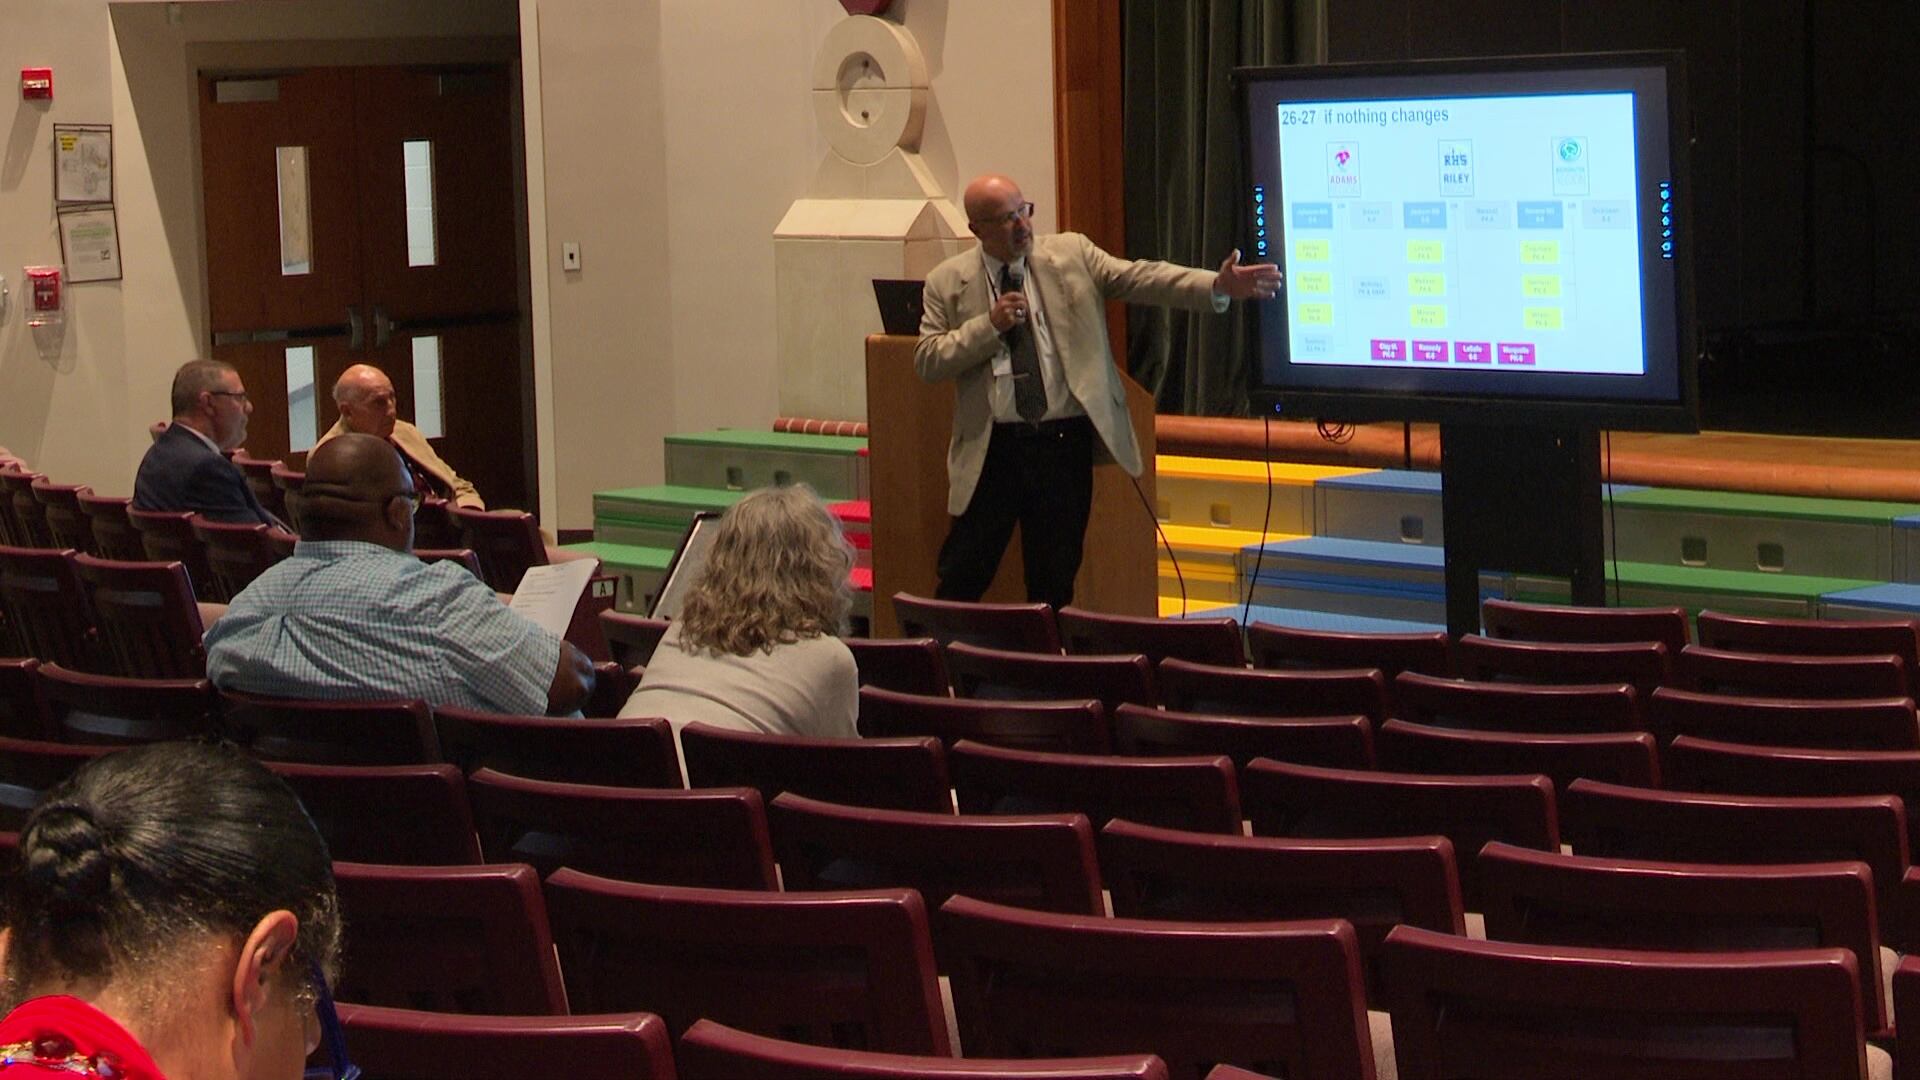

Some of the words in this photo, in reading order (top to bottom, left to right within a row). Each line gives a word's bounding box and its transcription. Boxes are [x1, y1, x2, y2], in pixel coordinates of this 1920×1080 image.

[1282, 110, 1316, 125] 26-27
[1324, 109, 1333, 124] if
[1337, 108, 1387, 127] nothing
[1391, 107, 1449, 126] changes
[1444, 154, 1468, 166] RHS
[1330, 175, 1358, 185] ADAMS
[1443, 173, 1470, 184] RILEY
[600, 582, 606, 595] A
